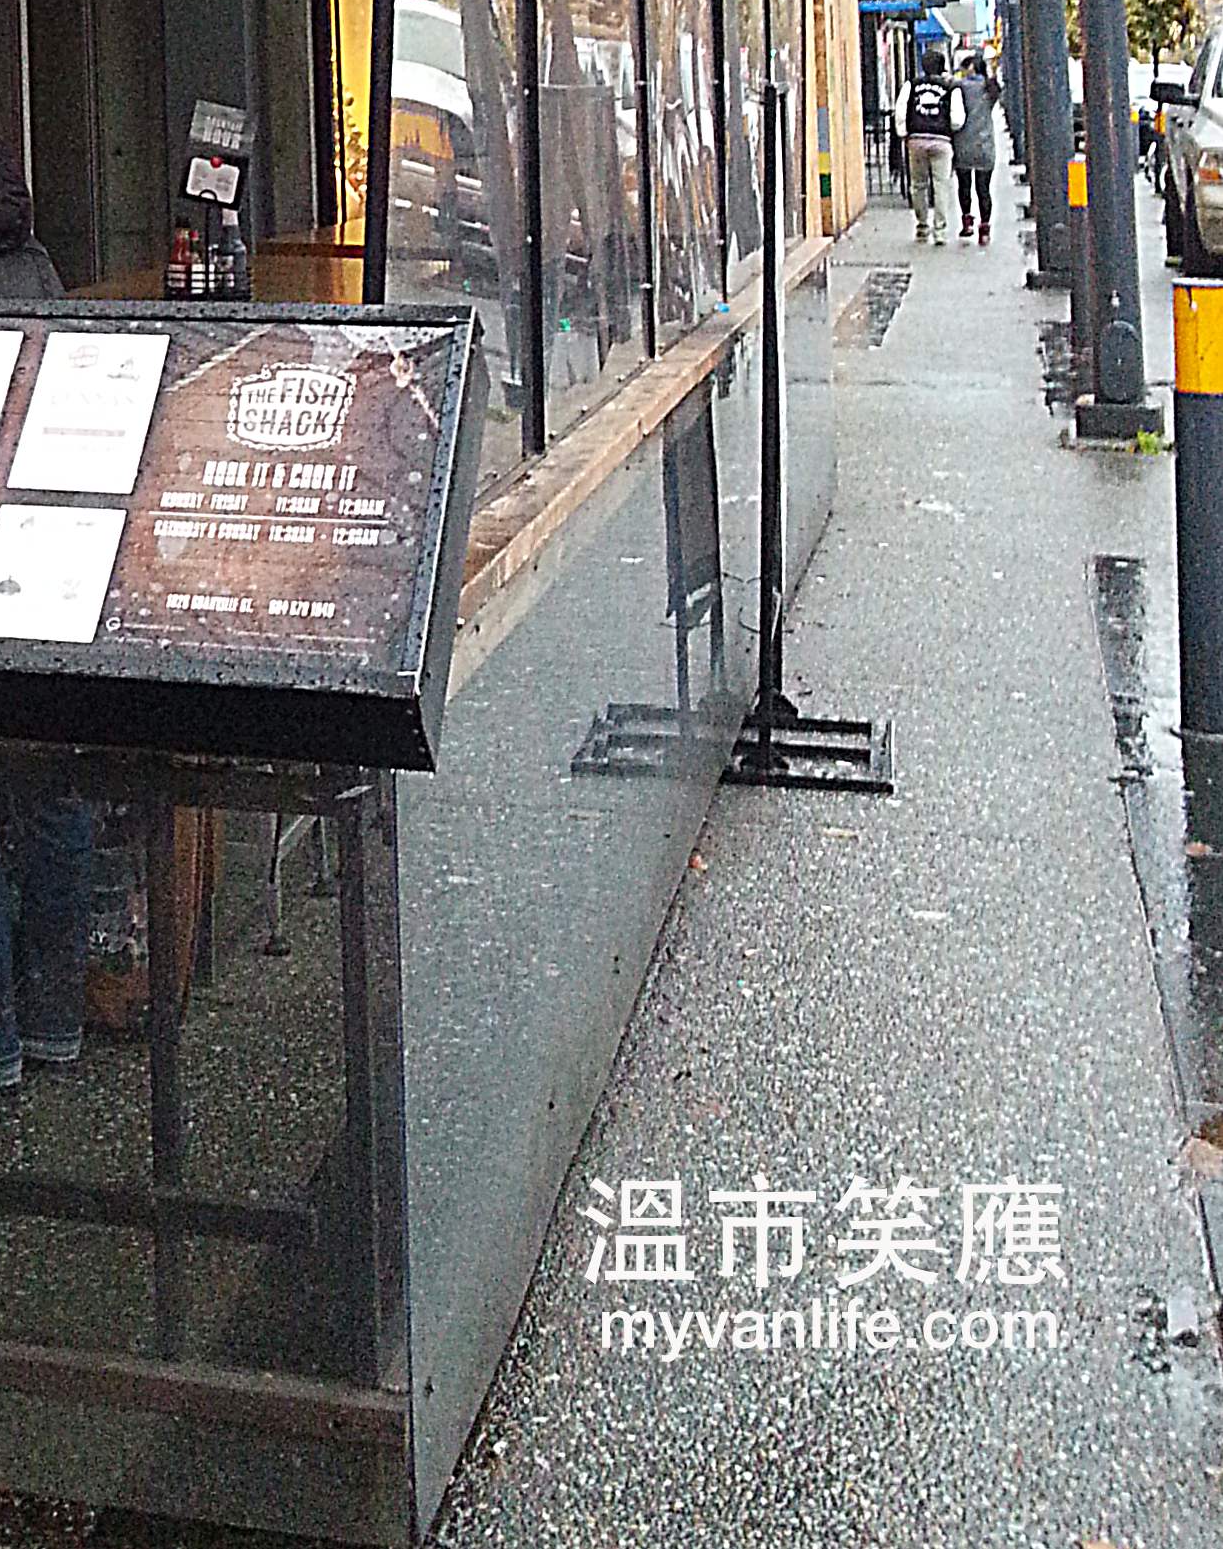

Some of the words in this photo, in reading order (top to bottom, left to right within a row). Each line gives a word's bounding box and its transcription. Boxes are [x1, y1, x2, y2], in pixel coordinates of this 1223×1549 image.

[247, 387, 277, 404] THE
[280, 377, 340, 406] FISH
[243, 409, 332, 437] SHACK
[252, 462, 270, 487] IT
[288, 464, 337, 490] COOK
[338, 465, 358, 491] IT
[159, 492, 205, 508] MONDAY
[210, 493, 249, 511] FRIDAY
[154, 520, 207, 538] SATURDAY
[217, 523, 261, 540] SUNDAY
